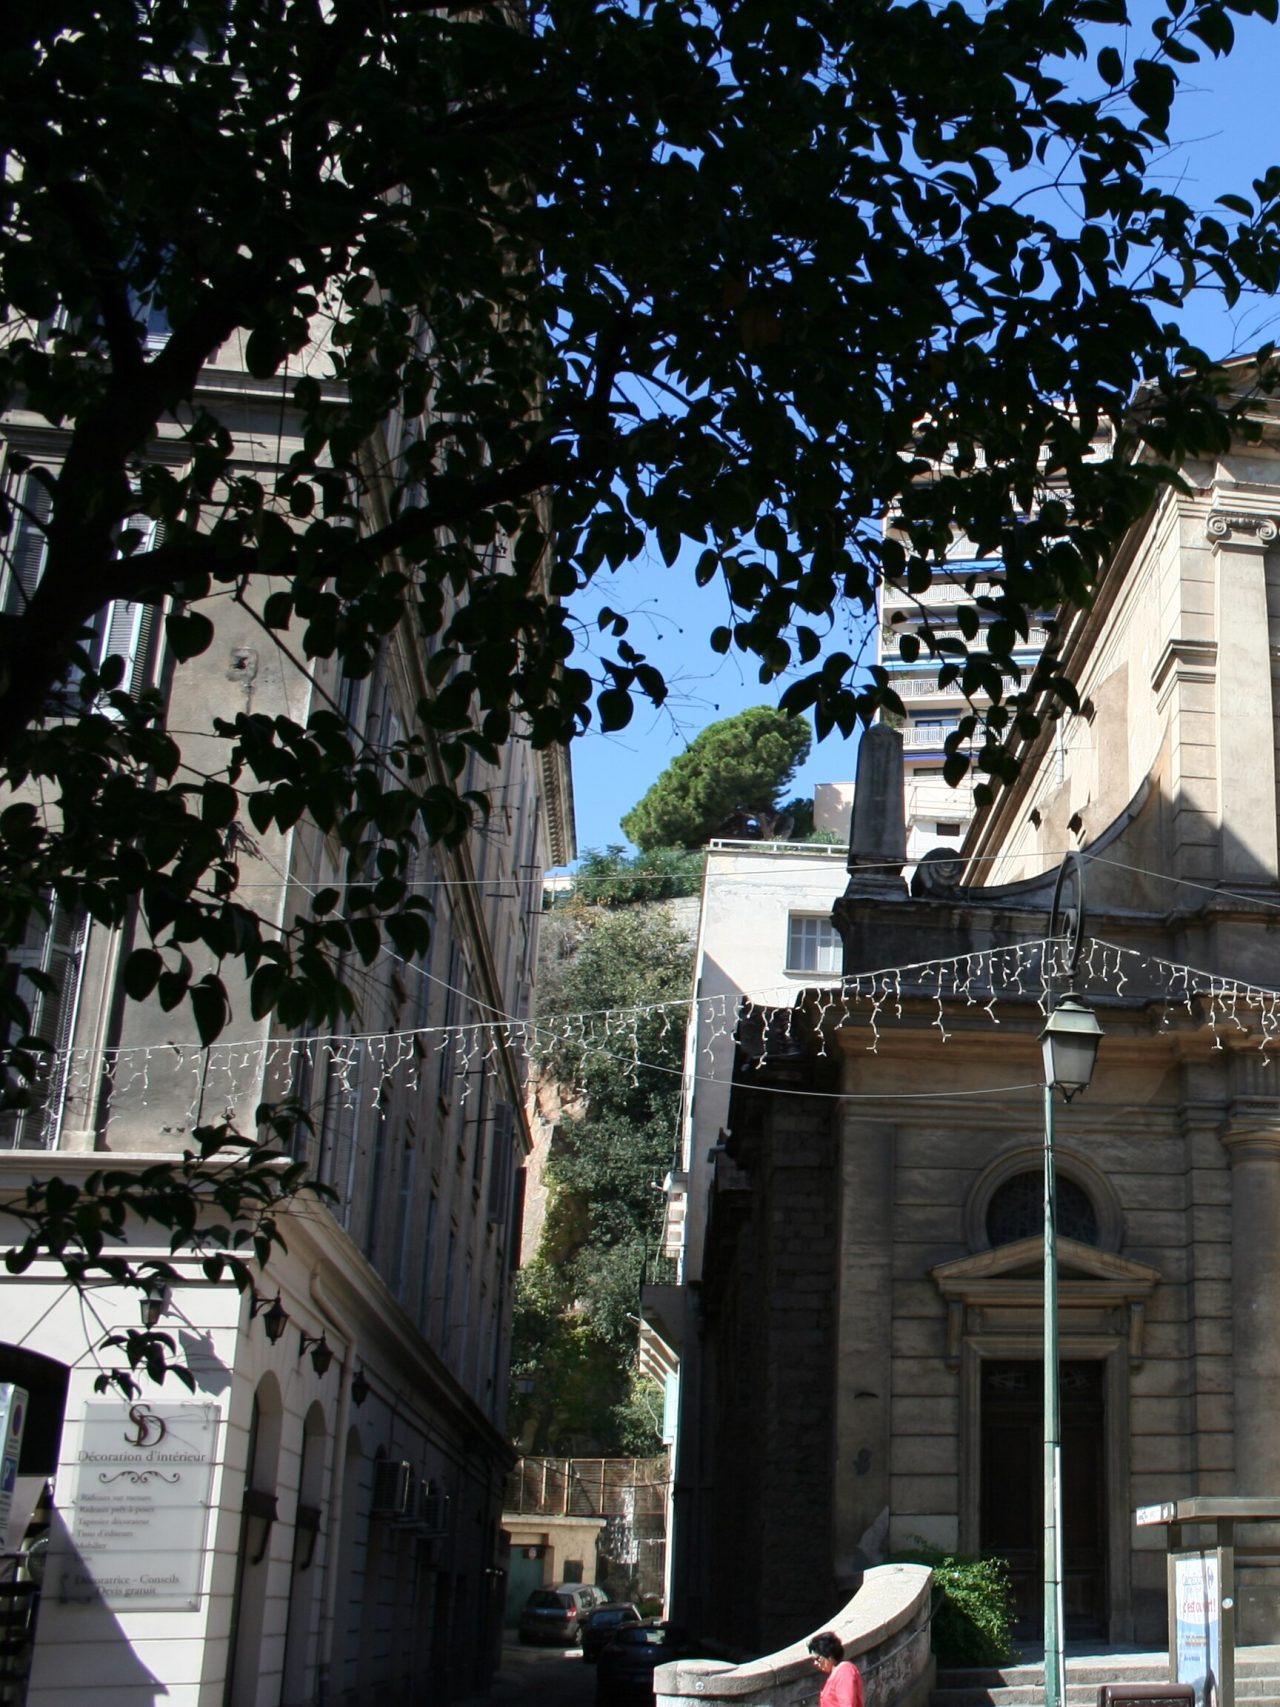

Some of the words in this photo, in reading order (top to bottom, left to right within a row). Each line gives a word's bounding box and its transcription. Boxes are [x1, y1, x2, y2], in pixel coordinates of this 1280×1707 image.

[78, 1450, 142, 1462] Décoration
[145, 1450, 206, 1462] d'intérieur
[139, 1573, 180, 1584] Conseils
[123, 1585, 157, 1597] gratuit
